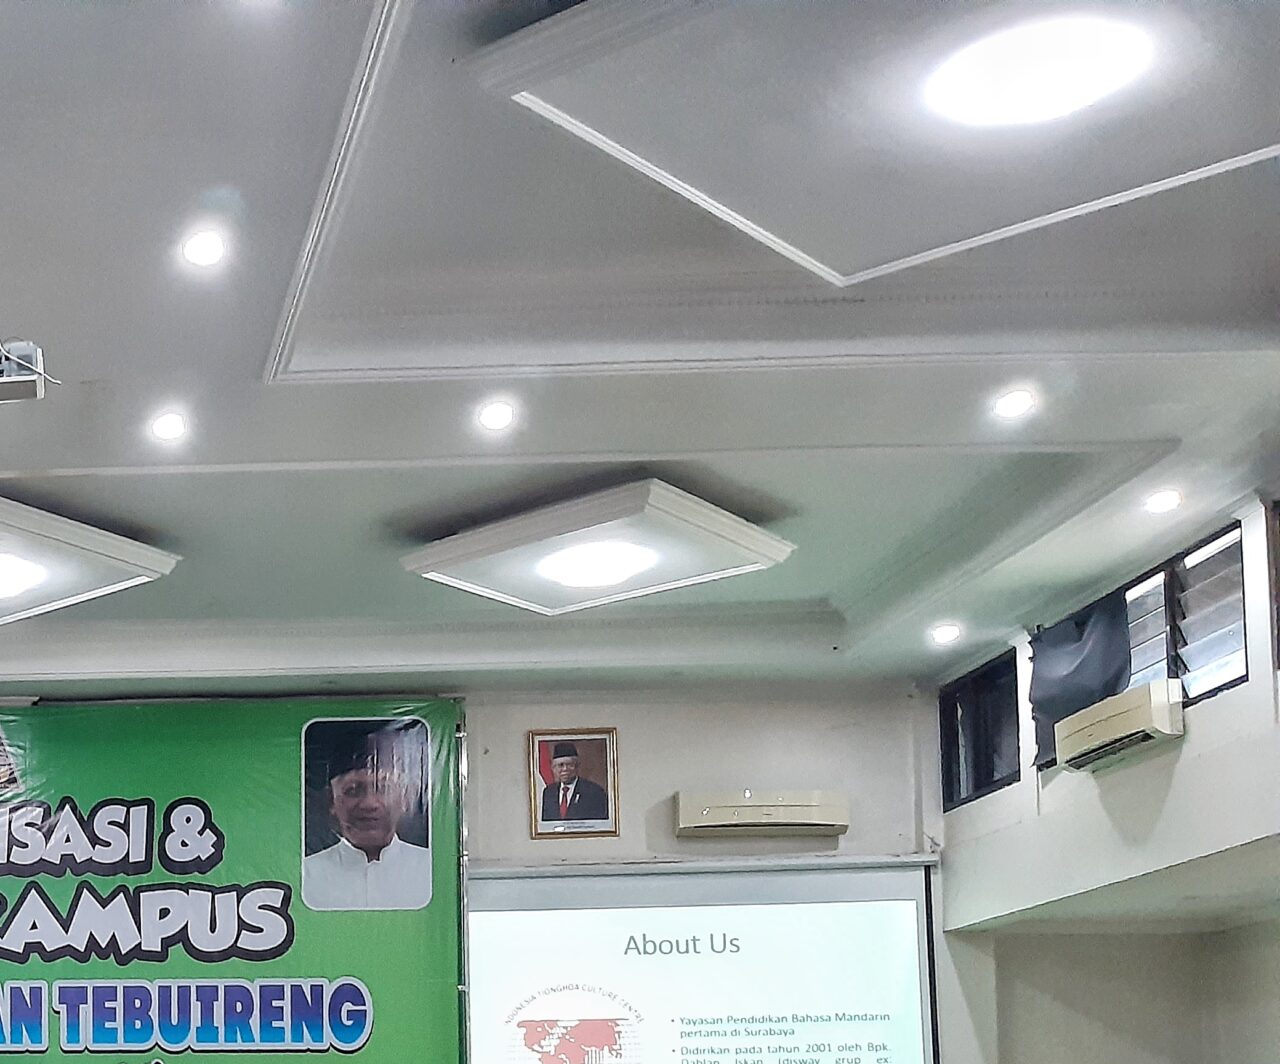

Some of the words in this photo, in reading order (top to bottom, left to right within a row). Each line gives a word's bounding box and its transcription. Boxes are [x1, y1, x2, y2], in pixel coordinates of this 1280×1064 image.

[162, 803, 220, 868] &
[624, 933, 701, 955] About
[710, 933, 740, 954] Us
[52, 981, 371, 1050] TEBUIRENG
[680, 1016, 723, 1026] Yayasan
[727, 1014, 788, 1024] Pendidikan
[792, 1013, 832, 1023] Bahasa
[835, 1012, 890, 1022] Mandarin
[680, 1029, 727, 1039] pertama
[731, 1028, 741, 1037] di
[744, 1027, 795, 1037] Surabaya
[681, 1046, 730, 1055] Didirikan
[735, 1046, 762, 1056] pada
[767, 1044, 800, 1054] tahun
[806, 1043, 832, 1053] 2001
[837, 1042, 862, 1052] oleh
[867, 1042, 891, 1052] Bpk.
[876, 1056, 892, 1064] ex:
